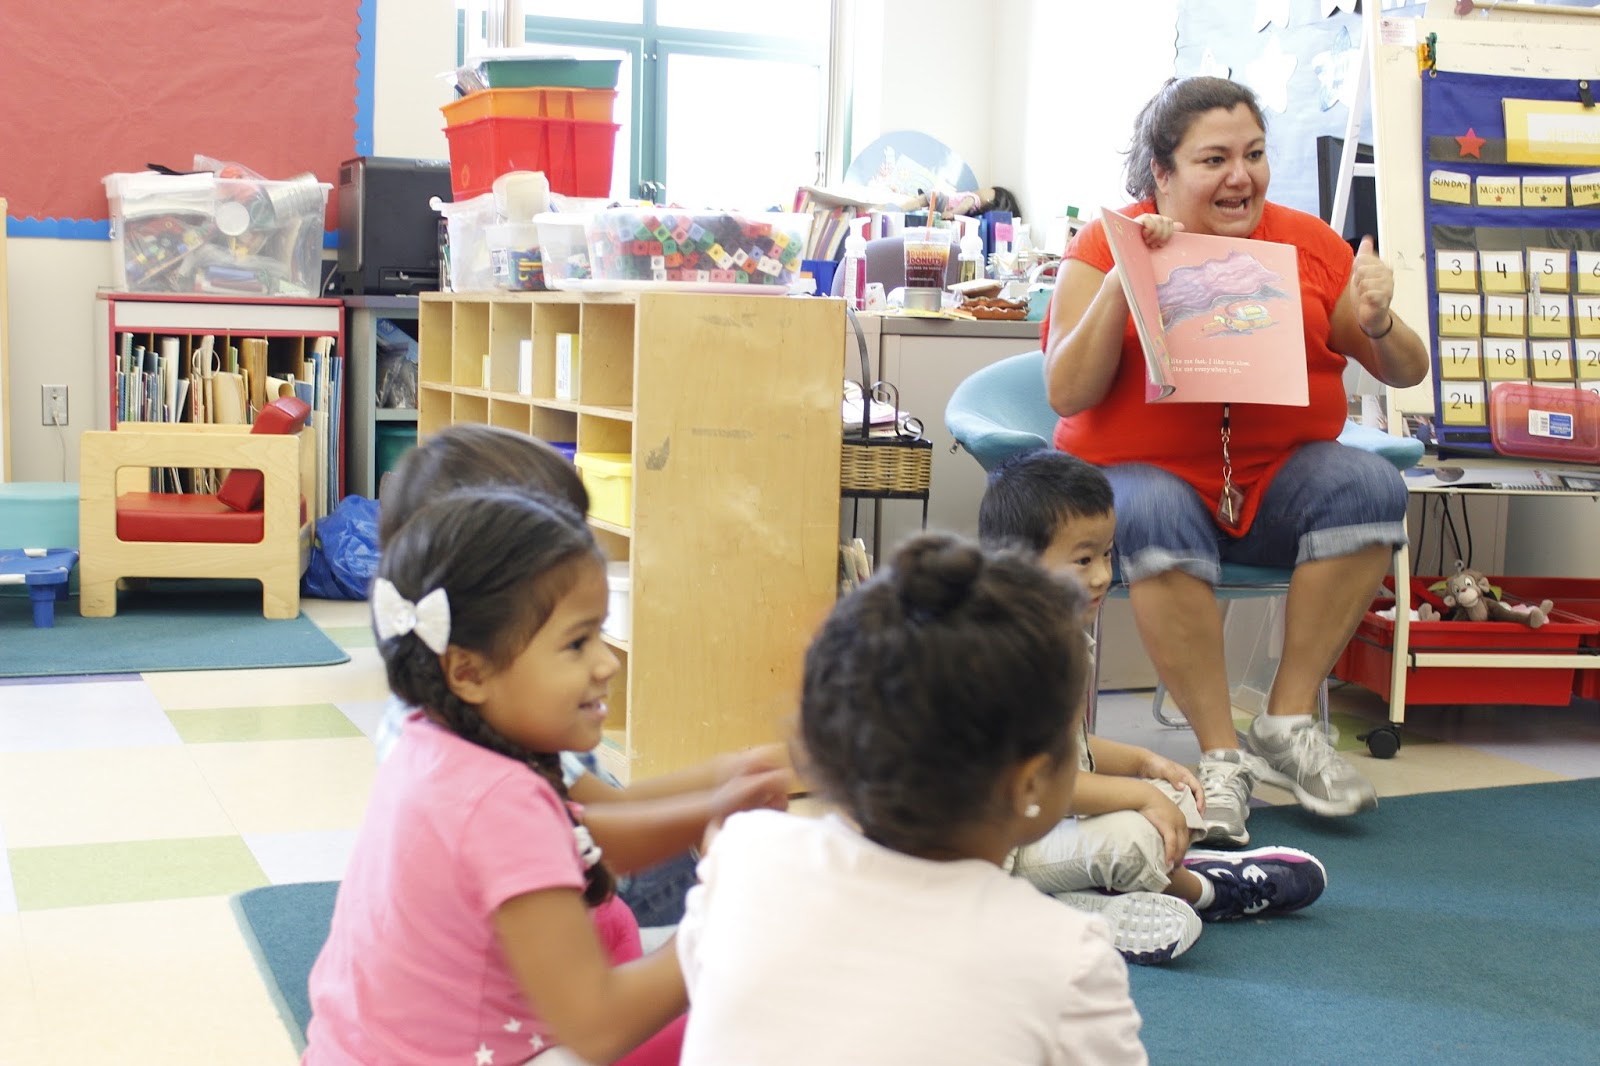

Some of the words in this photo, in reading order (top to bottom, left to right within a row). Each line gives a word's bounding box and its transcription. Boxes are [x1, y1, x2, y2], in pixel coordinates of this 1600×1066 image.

[1432, 177, 1468, 190] SUNDAY
[1480, 186, 1516, 194] MONDAY
[1524, 186, 1564, 194] TUESDAY
[910, 257, 942, 265] DONUTS
[1451, 259, 1462, 276] 3
[1496, 261, 1507, 279] 4
[1543, 258, 1553, 275] 5
[1593, 261, 1600, 278] 6
[1451, 304, 1472, 322] 10
[1497, 304, 1513, 322] 11
[1541, 305, 1561, 322] 12
[1451, 347, 1470, 364] 17
[1496, 348, 1516, 365] 18
[1543, 350, 1562, 366] 19
[1586, 350, 1600, 367] 2
[1450, 392, 1473, 409] 24
